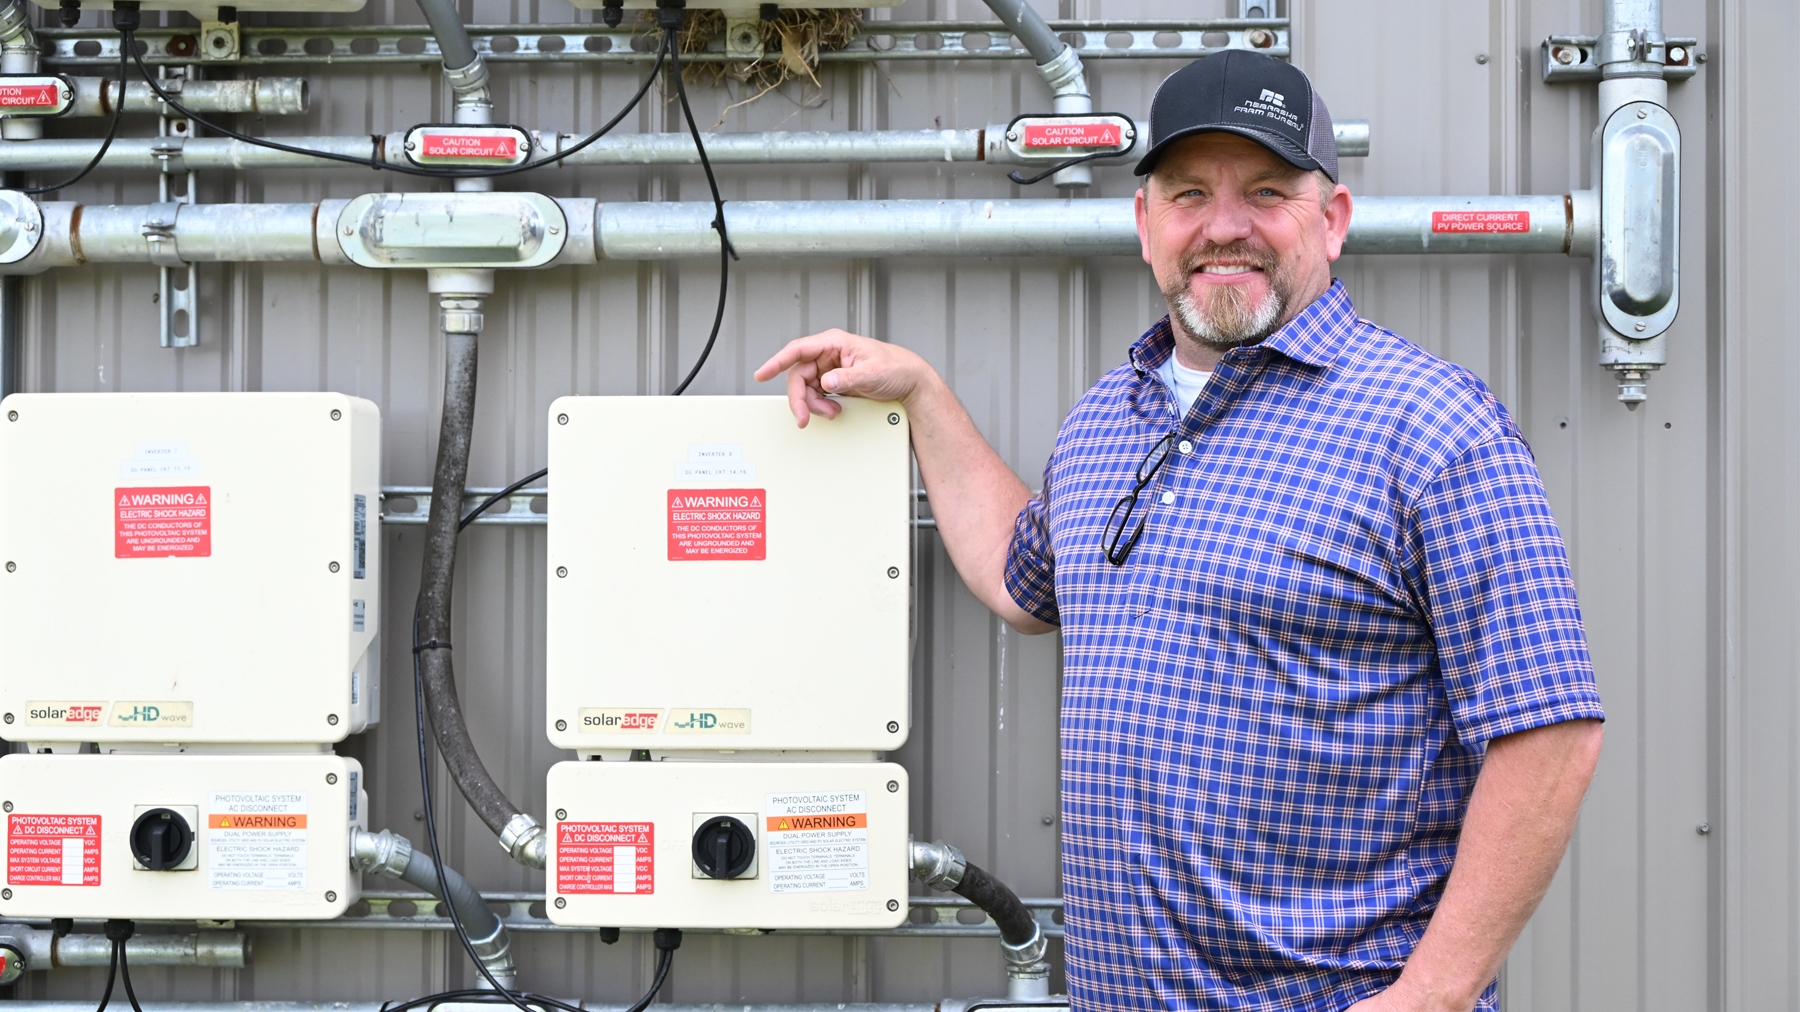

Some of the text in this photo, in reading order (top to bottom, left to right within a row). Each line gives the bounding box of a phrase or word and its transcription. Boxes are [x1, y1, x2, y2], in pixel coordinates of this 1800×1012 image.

[1234, 106, 1264, 115] FARM
[443, 138, 480, 146] CAUTION
[1064, 136, 1098, 144] CIRCUIT
[1452, 222, 1484, 230] POWER
[131, 493, 194, 505] WARNING
[685, 496, 748, 508] WARNING
[120, 509, 206, 518] ELECTRIC SHOCK HAZARD
[30, 706, 101, 722] solaredge
[133, 706, 160, 721] HD
[584, 713, 657, 729] solaredge
[690, 713, 717, 728] HD
[773, 794, 859, 804] PHOTOVOLTAIC SYSTEM
[799, 804, 846, 813] DISCONNECT
[12, 817, 97, 825] PHOTOVOLTAIC SYSTEM
[233, 816, 296, 827] WARNING
[792, 816, 856, 828] WARNING
[25, 826, 84, 834] DC DISCONNECT
[574, 834, 636, 842] DC DISCONNECT
